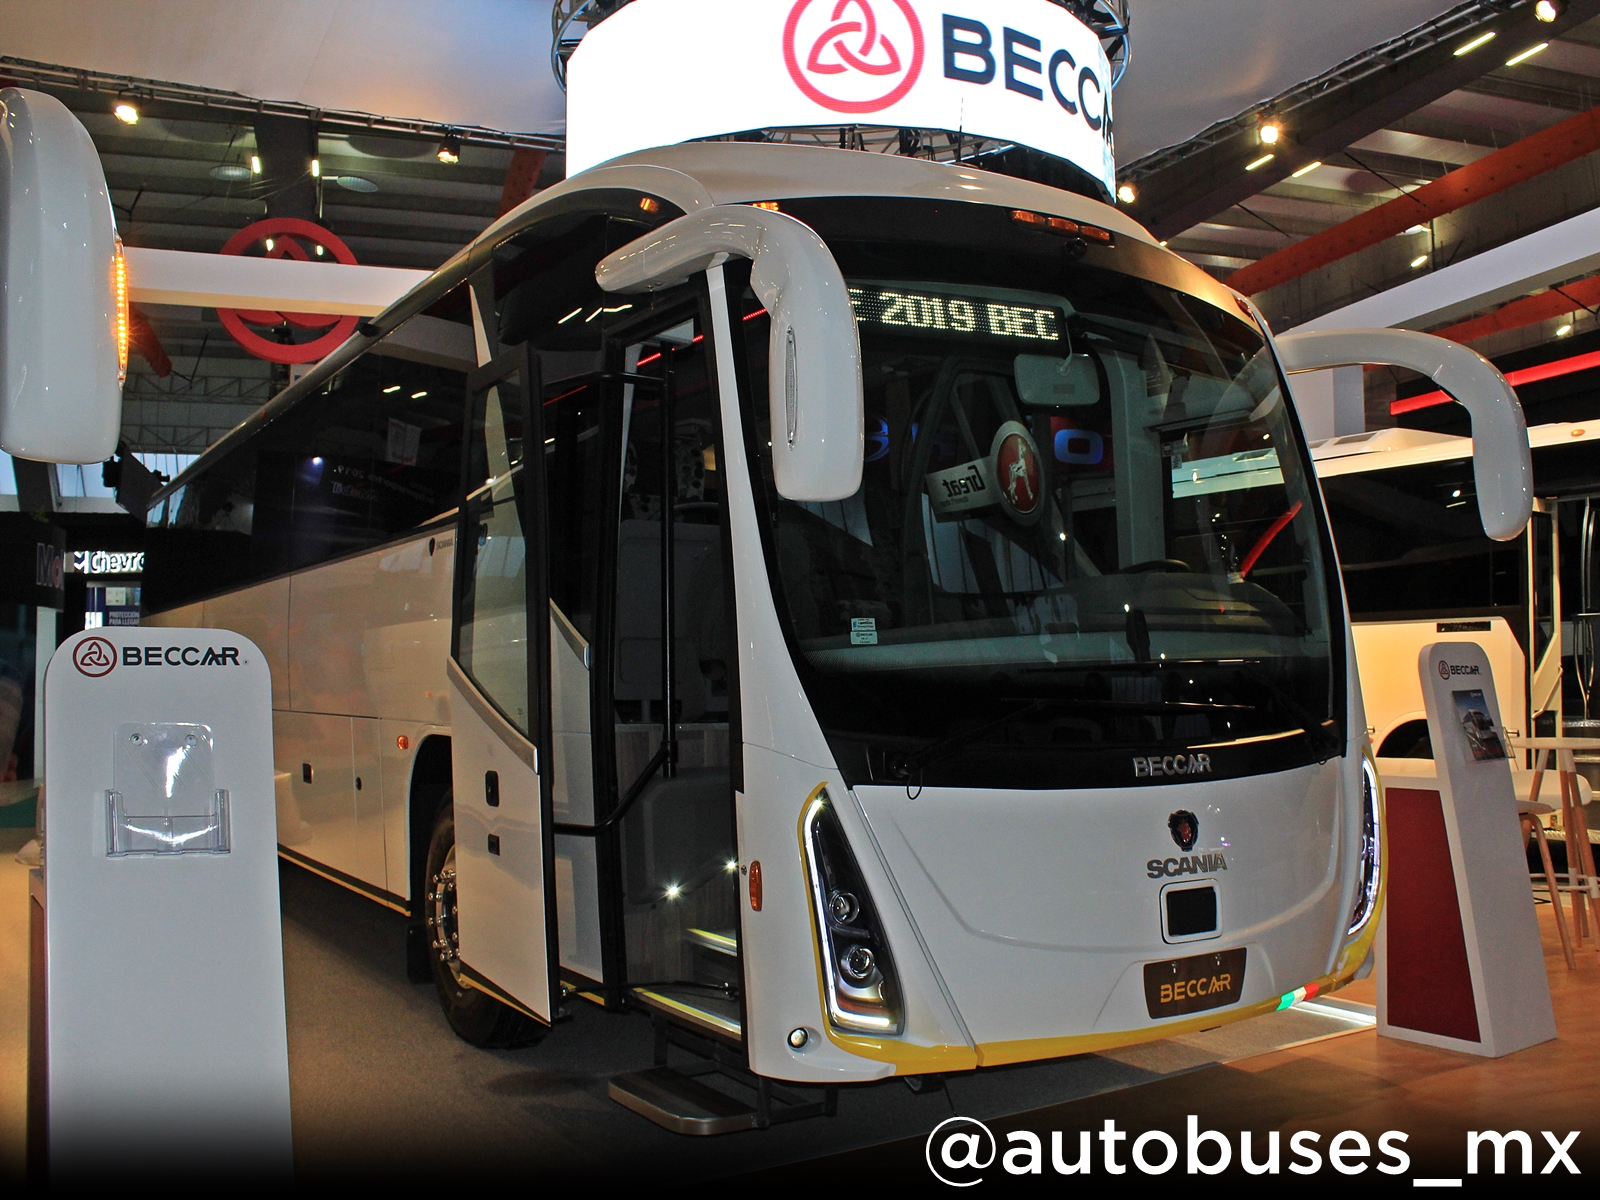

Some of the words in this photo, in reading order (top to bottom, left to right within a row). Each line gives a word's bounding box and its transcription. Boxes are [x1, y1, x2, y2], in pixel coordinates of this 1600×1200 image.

[879, 291, 976, 332] 2019
[987, 303, 1059, 341] BEC
[122, 646, 240, 666] BECCAR
[1450, 665, 1480, 675] BECCAR
[1133, 753, 1212, 777] BECCAR
[1146, 852, 1228, 879] SCANIA
[1160, 973, 1231, 1003] BECCAR
